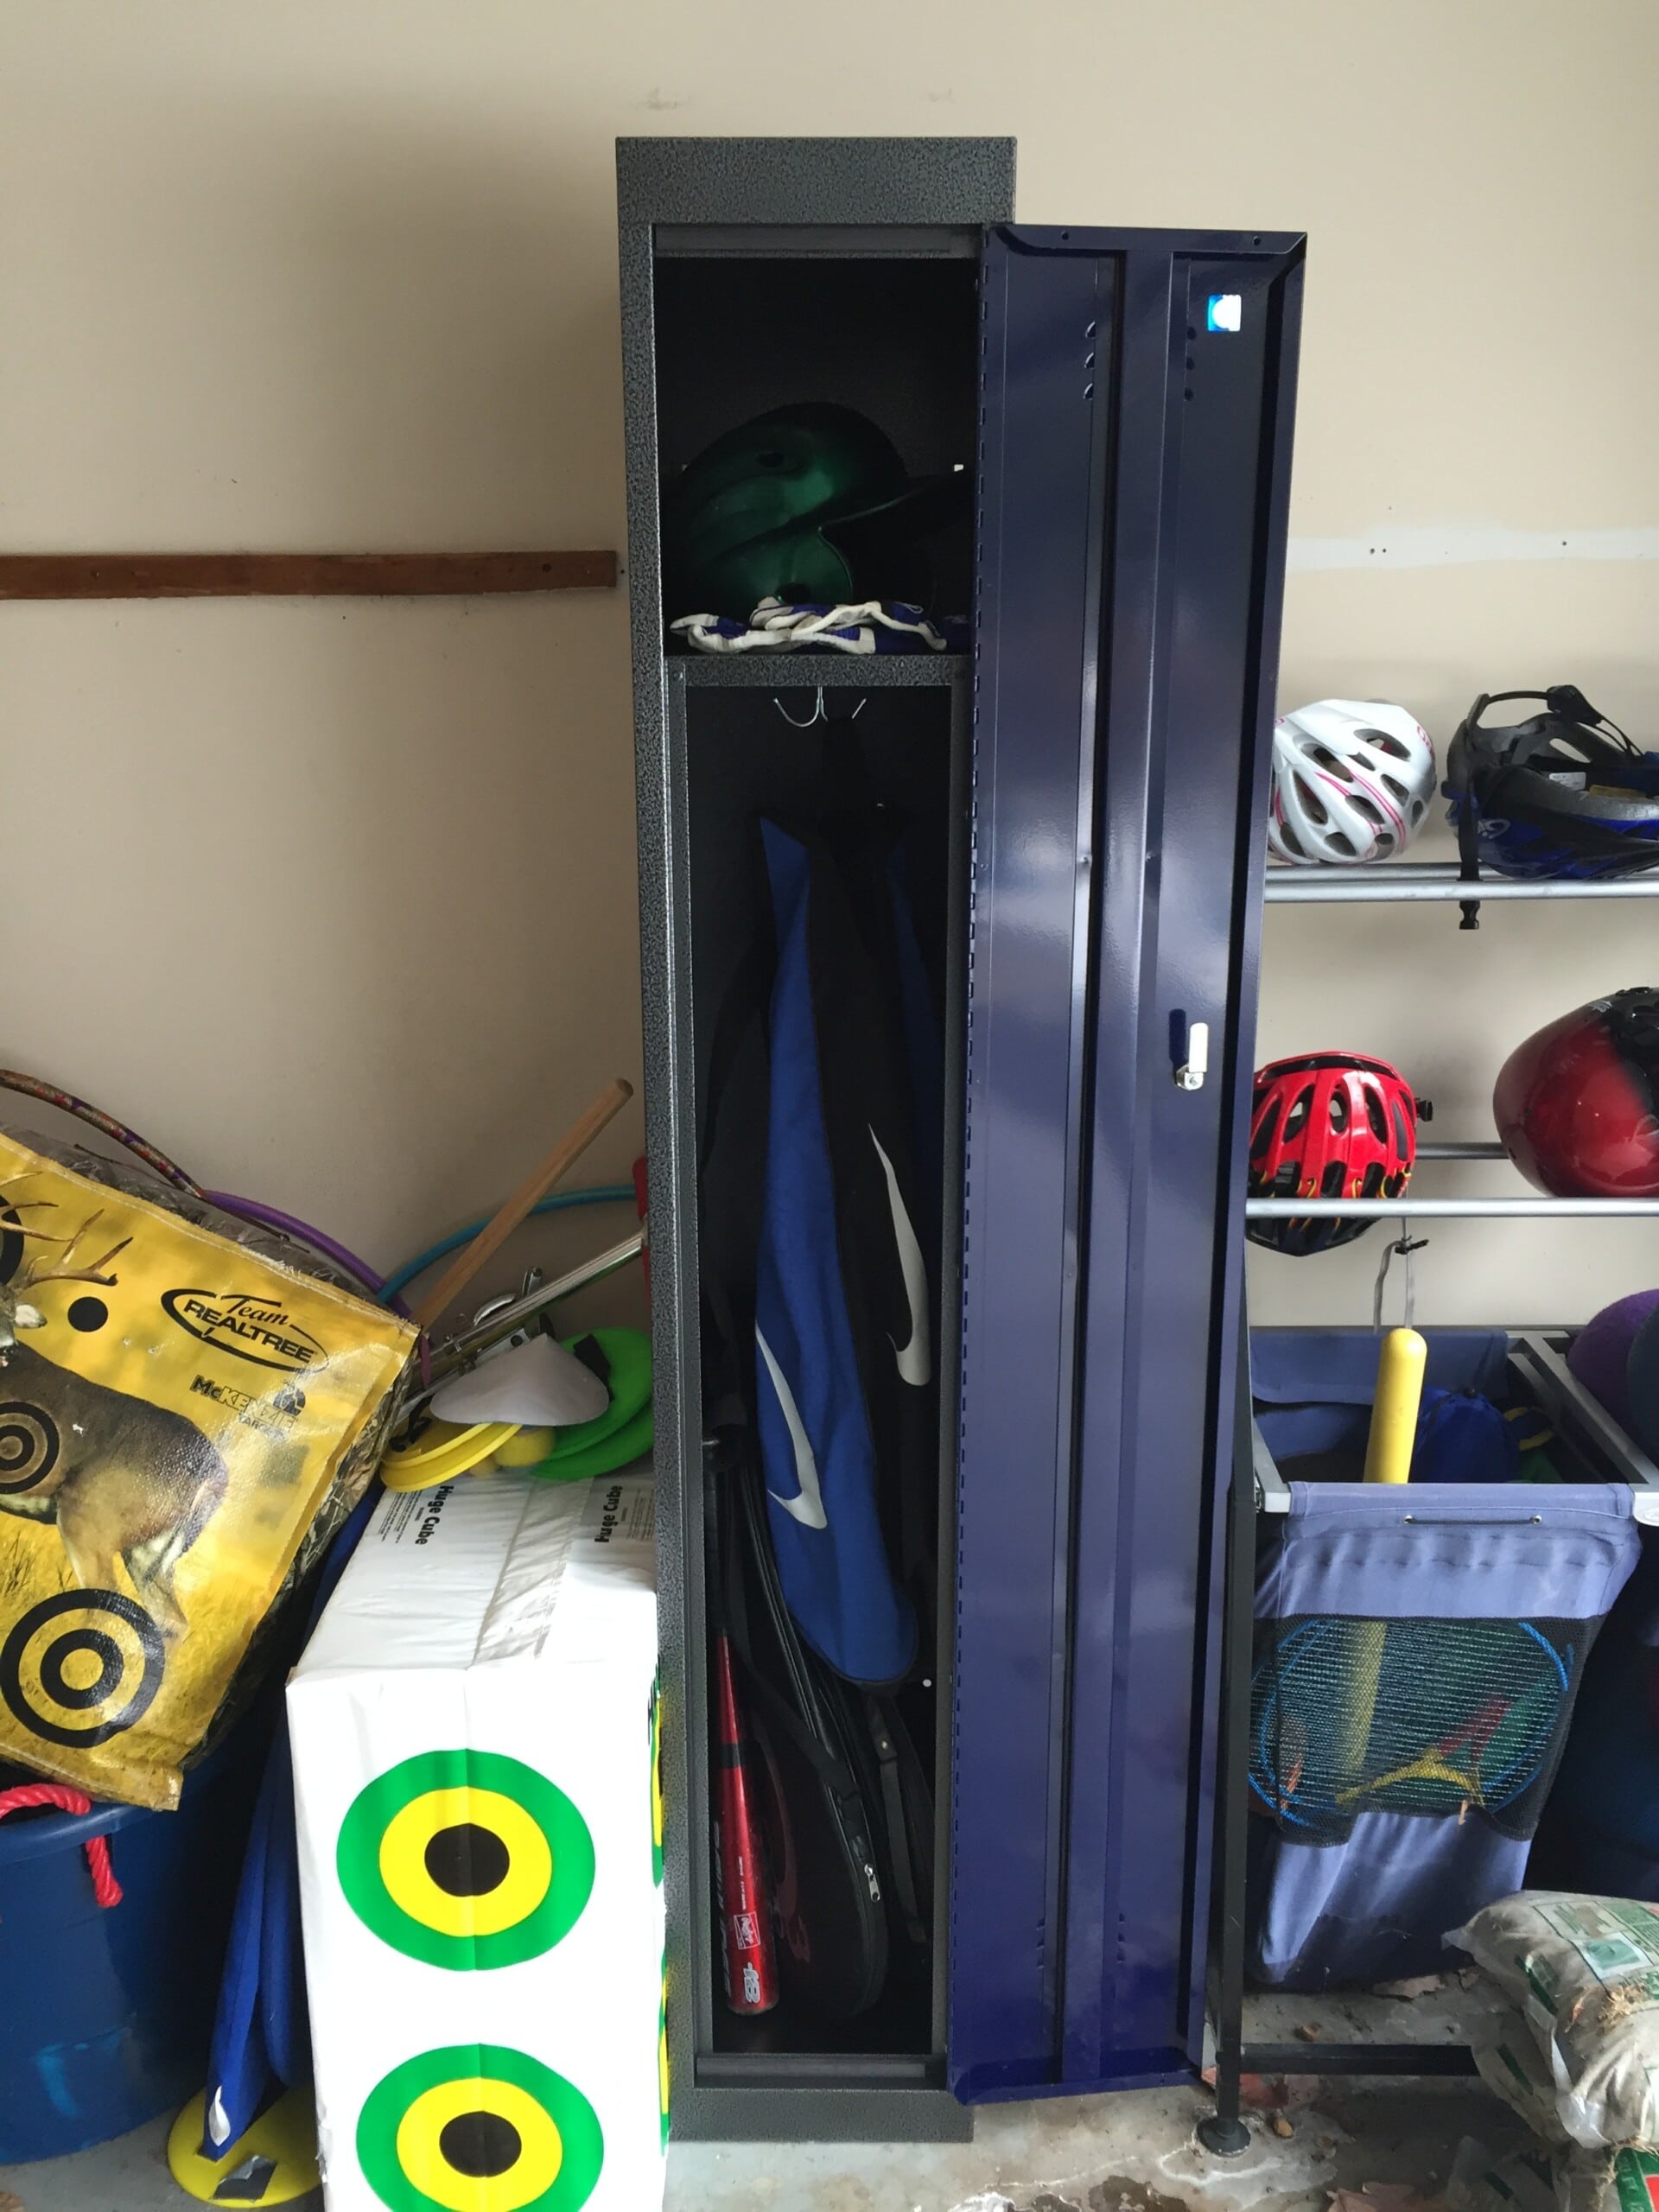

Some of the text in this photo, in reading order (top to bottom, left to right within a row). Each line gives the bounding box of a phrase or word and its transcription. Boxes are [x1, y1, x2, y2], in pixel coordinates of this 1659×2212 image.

[183, 1300, 315, 1363] REALTREE
[221, 1294, 289, 1326] Team
[415, 1485, 454, 1545] Huge Cube
[594, 1485, 623, 1542] Huge Cube
